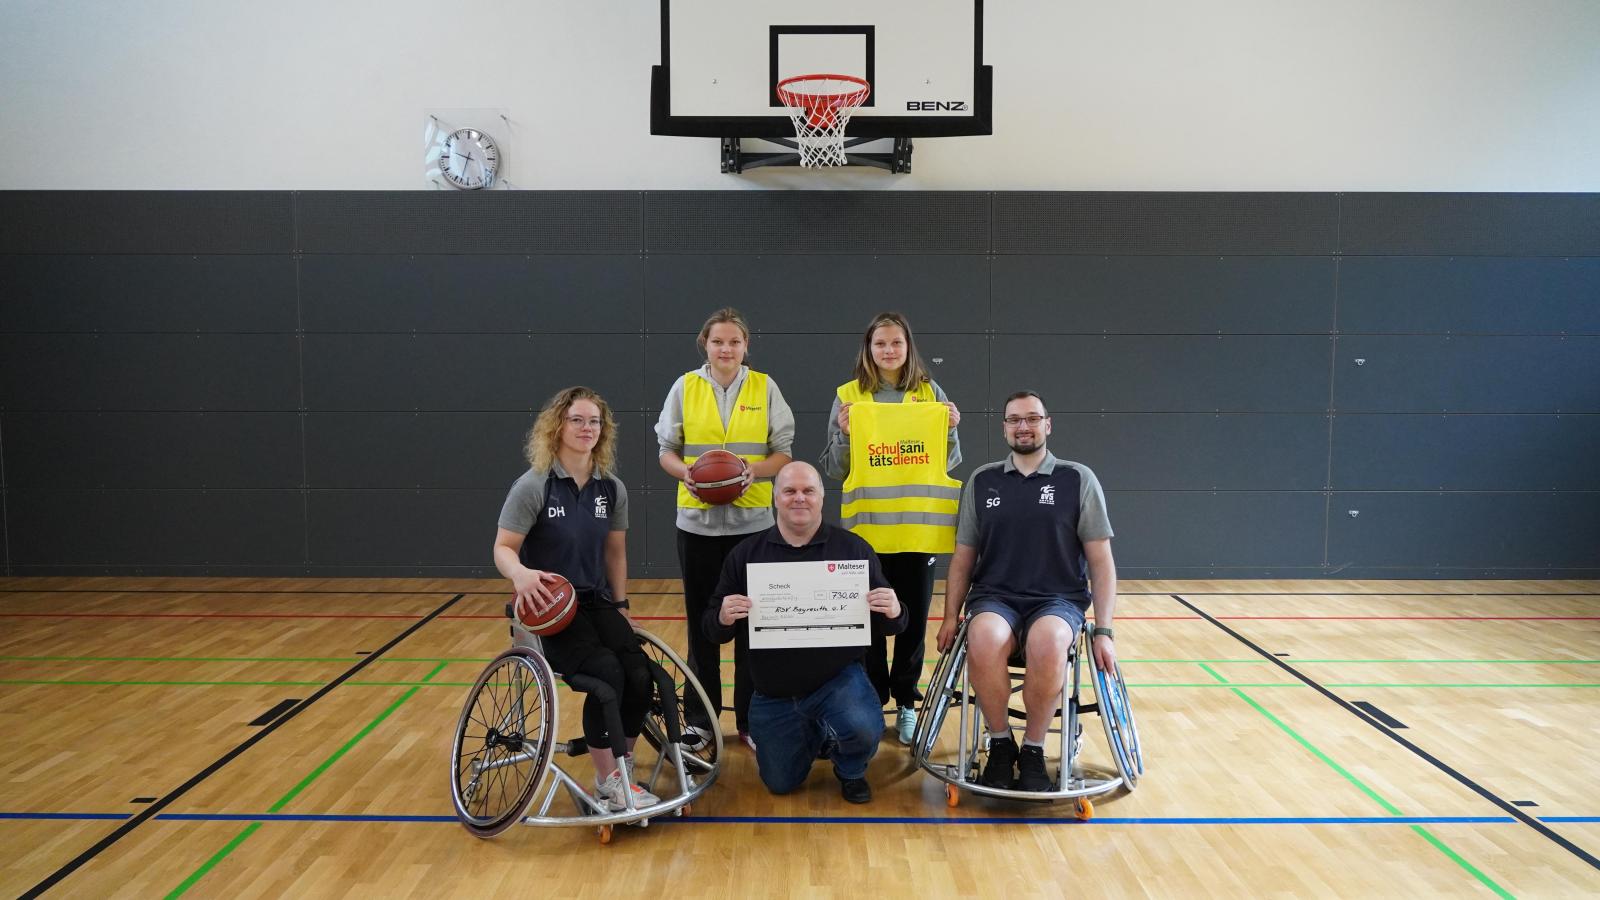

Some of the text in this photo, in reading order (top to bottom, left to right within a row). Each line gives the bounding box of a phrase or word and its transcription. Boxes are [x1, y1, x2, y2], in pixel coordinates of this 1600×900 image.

[869, 453, 930, 467] tätsdienst
[986, 497, 1000, 508] SG
[548, 506, 566, 518] DH
